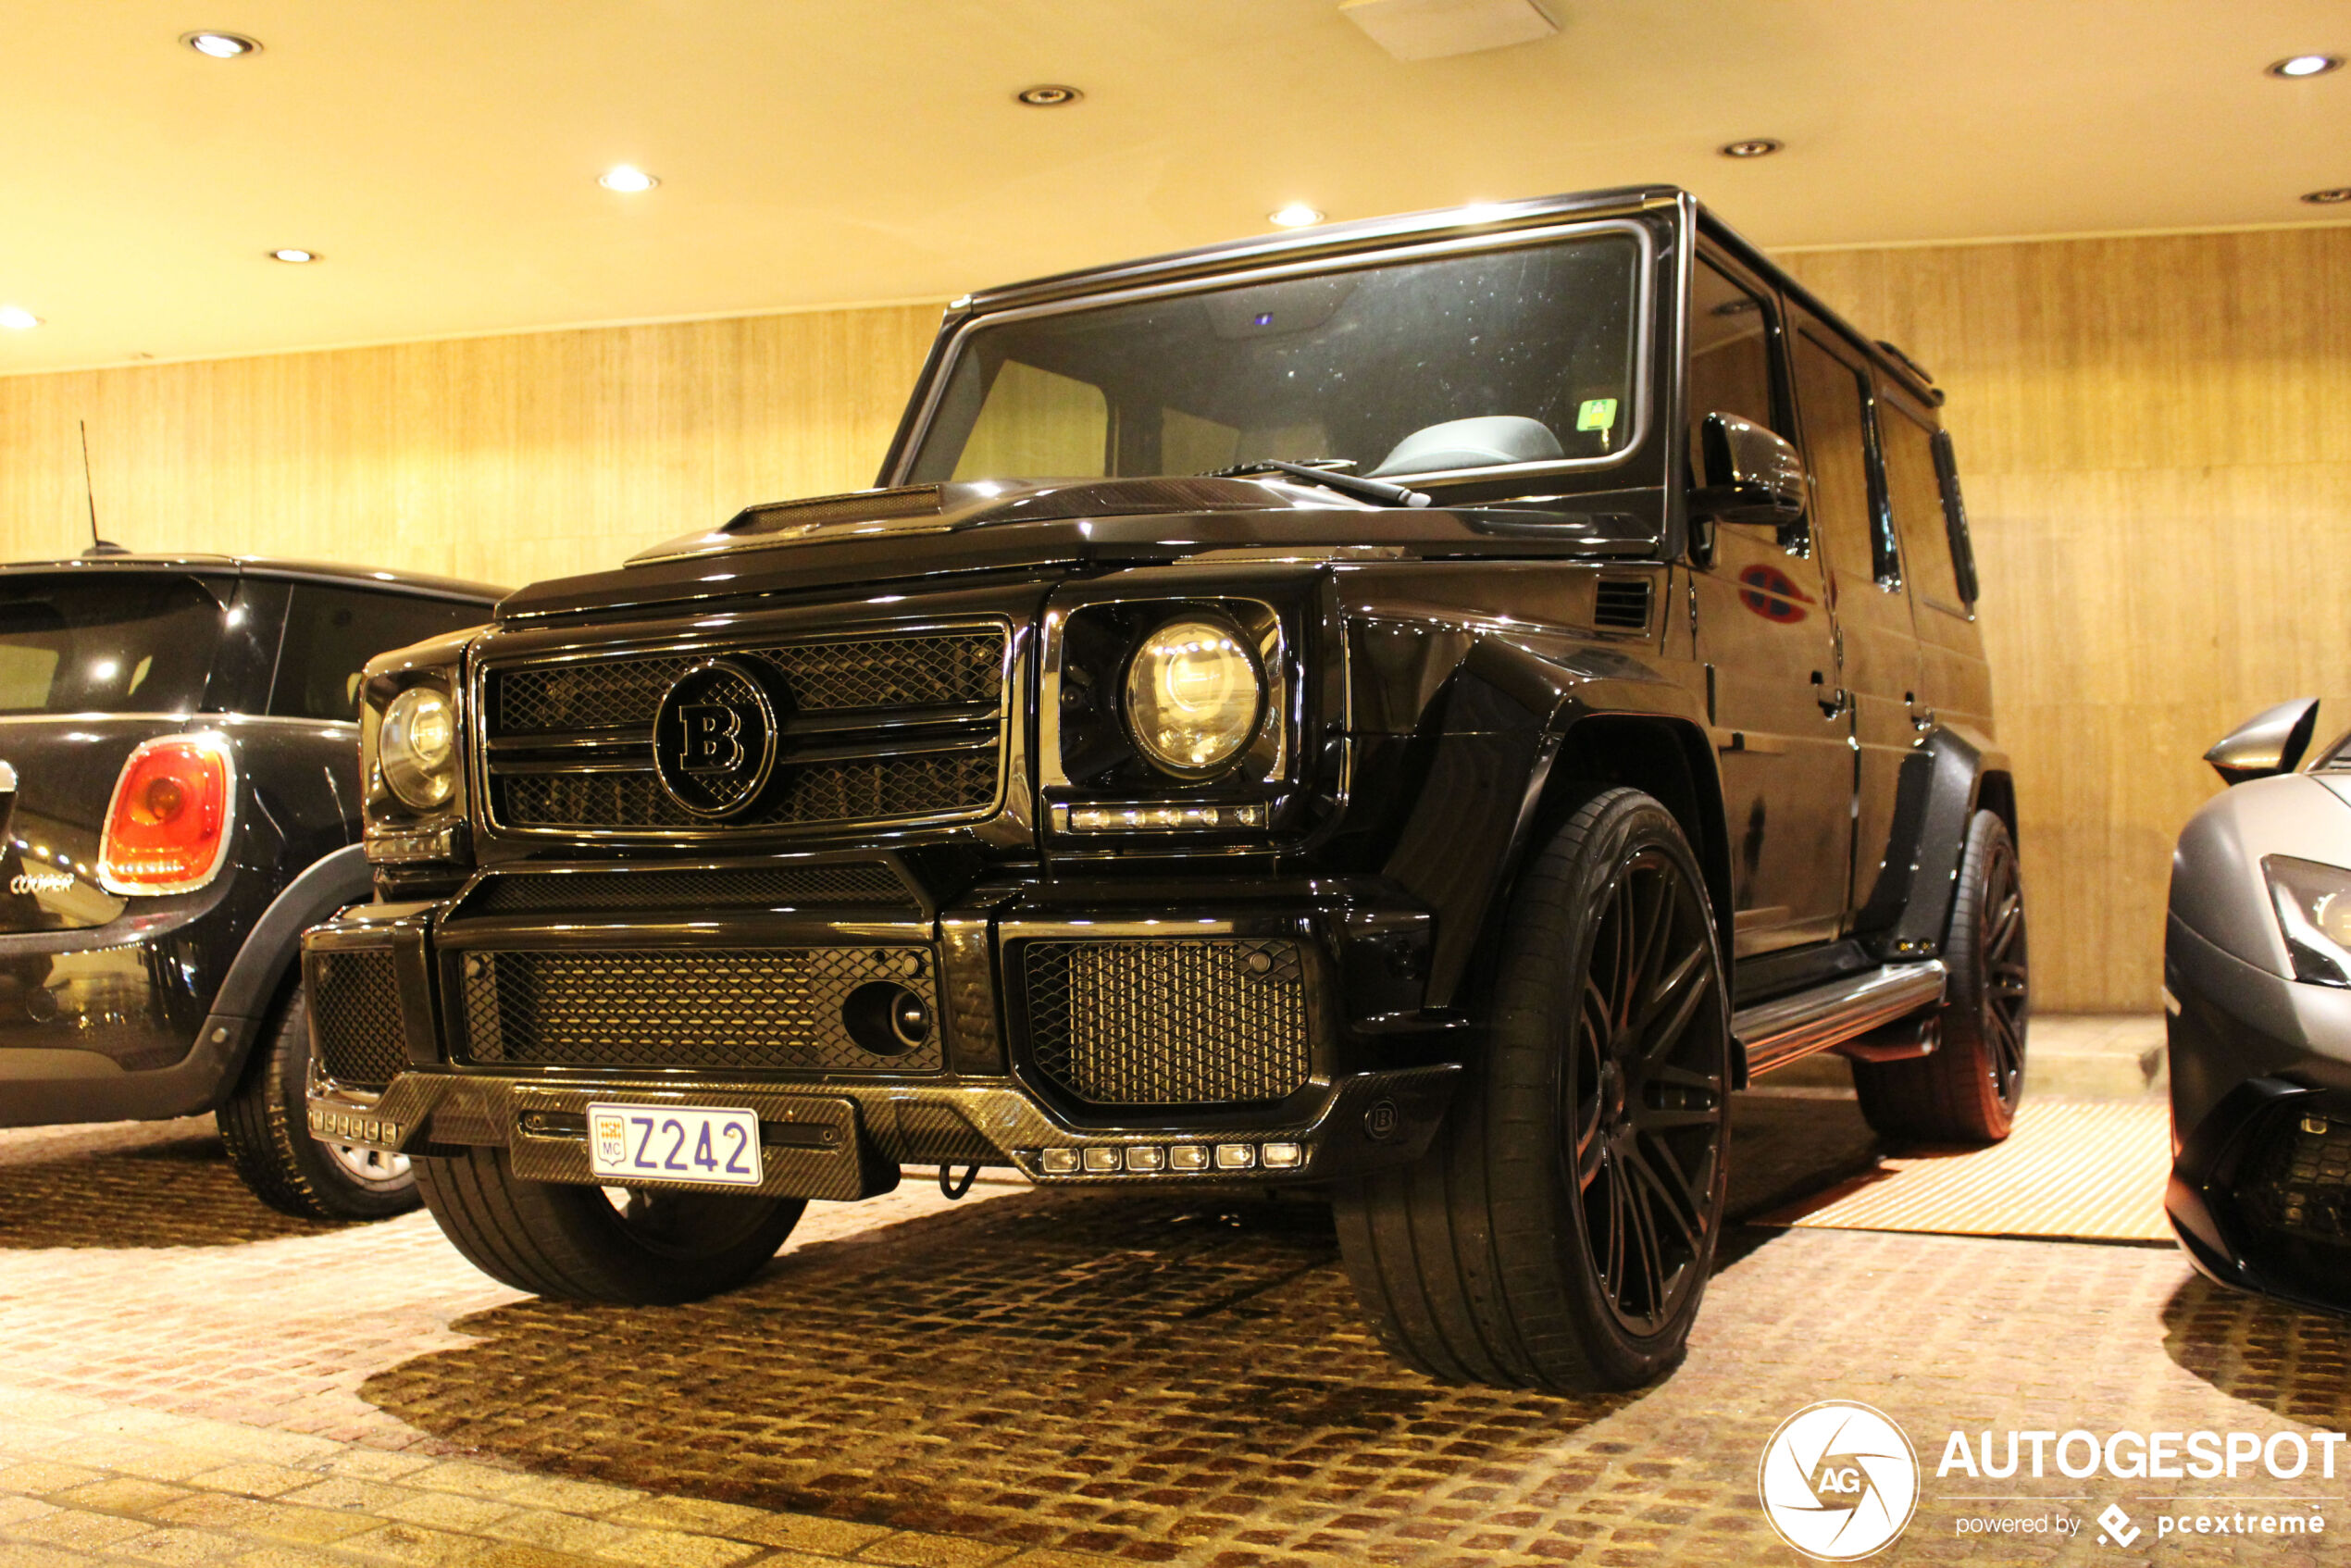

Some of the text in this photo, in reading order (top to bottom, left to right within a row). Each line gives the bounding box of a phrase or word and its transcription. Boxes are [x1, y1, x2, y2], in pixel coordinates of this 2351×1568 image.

[678, 703, 745, 775] B
[10, 872, 74, 895] COOPER
[1375, 1109, 1393, 1131] B
[603, 1141, 622, 1157] MC
[631, 1117, 751, 1175] Z242
